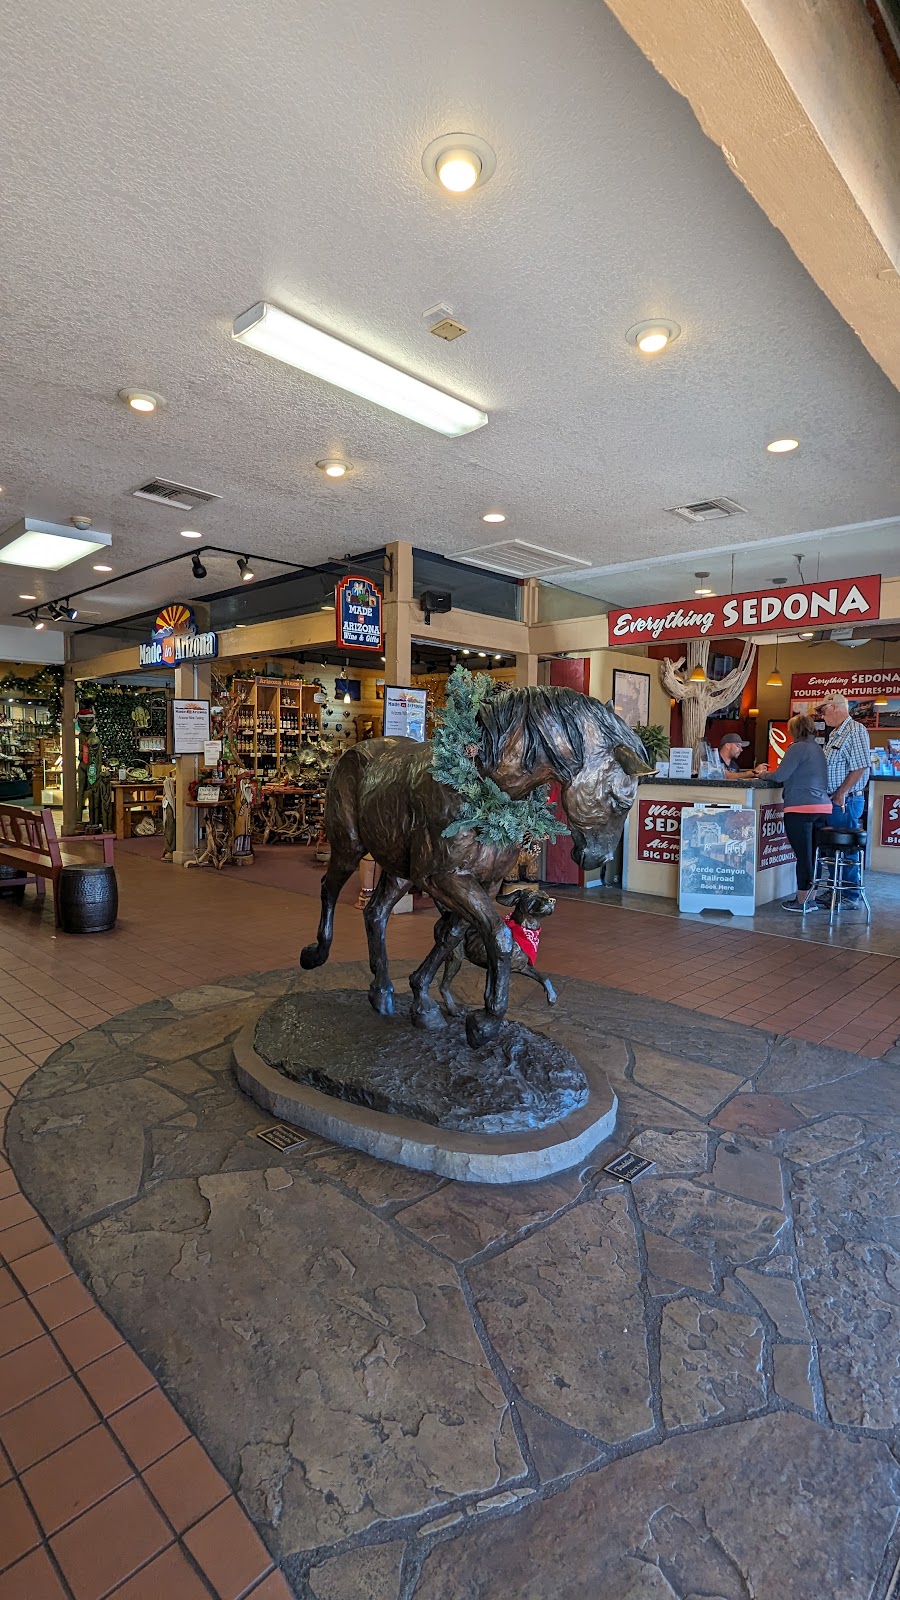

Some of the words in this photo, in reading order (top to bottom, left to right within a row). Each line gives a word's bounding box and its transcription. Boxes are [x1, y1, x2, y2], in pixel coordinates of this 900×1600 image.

[348, 605, 373, 617] MADE
[613, 609, 715, 639] Everything
[722, 584, 871, 628] SEDONA
[343, 621, 380, 634] ARIZONA
[343, 631, 358, 641] Wine
[365, 635, 380, 643] Gifts
[139, 642, 162, 665] Made
[164, 645, 172, 658] in
[174, 632, 215, 660] Arizona
[808, 676, 849, 687] Everything
[851, 672, 900, 684] SEDONA
[644, 816, 681, 832] SED
[646, 838, 669, 849] Ask
[643, 850, 661, 859] BIG
[715, 867, 746, 875] Canyon
[701, 874, 735, 882] Railroad
